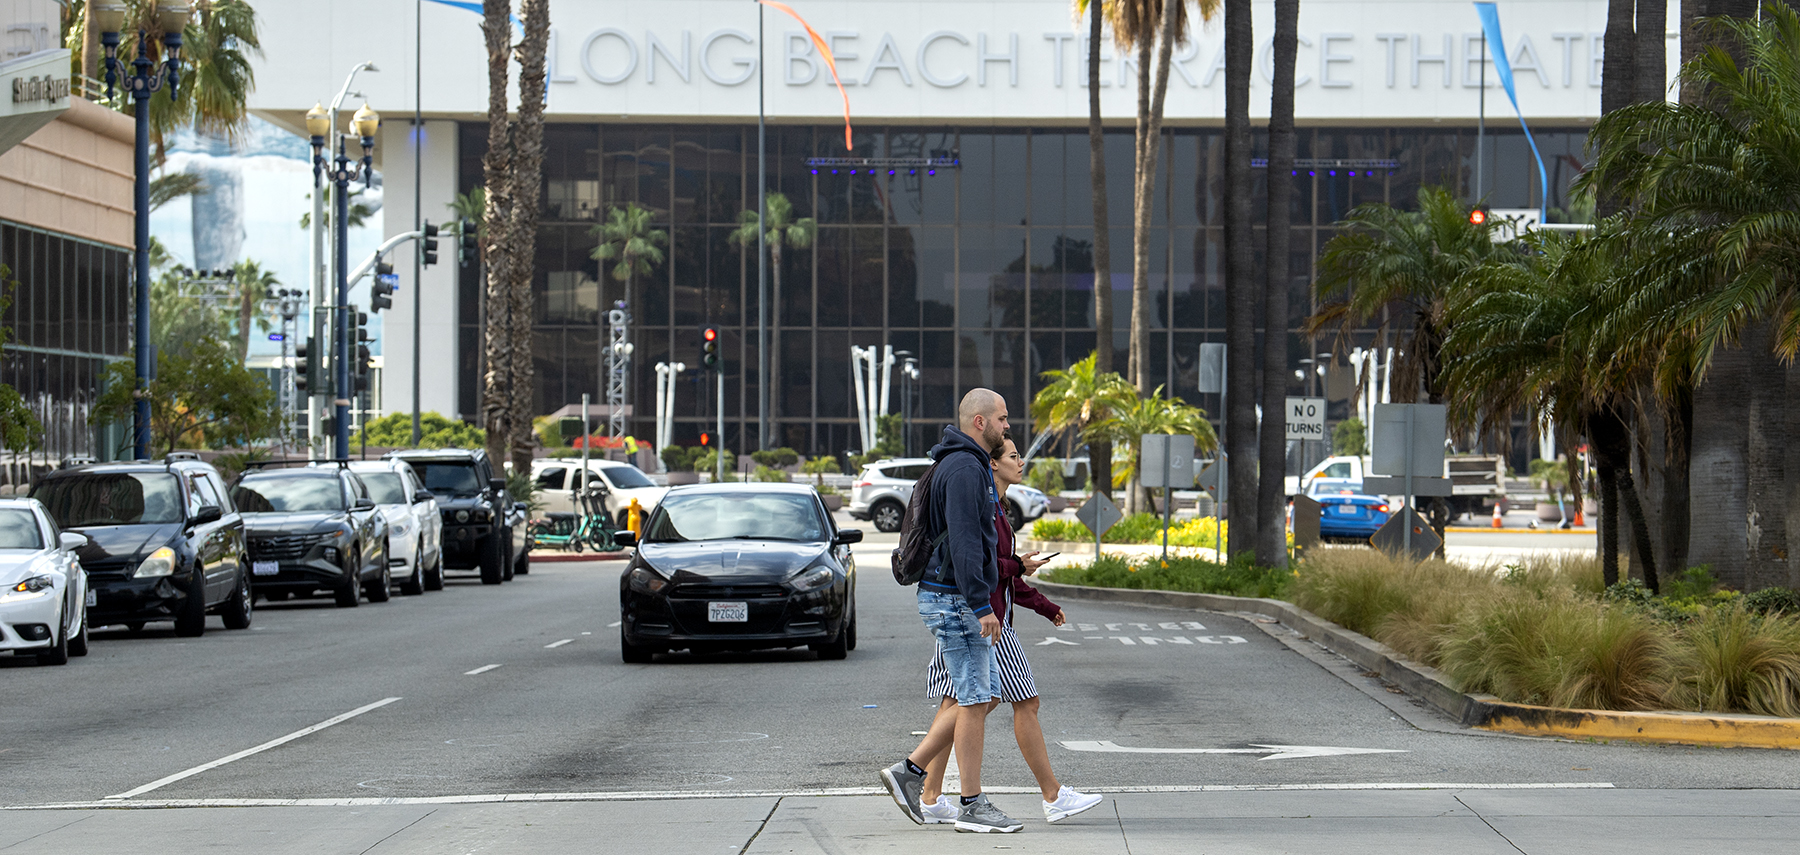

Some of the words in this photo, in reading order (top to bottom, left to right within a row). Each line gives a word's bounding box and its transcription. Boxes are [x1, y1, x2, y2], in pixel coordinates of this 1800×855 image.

[549, 27, 759, 87] LONG
[783, 29, 1018, 88] BEACH
[1294, 404, 1316, 417] NO
[1286, 422, 1322, 434] TURNS
[711, 608, 745, 620] 7PZG2Q6
